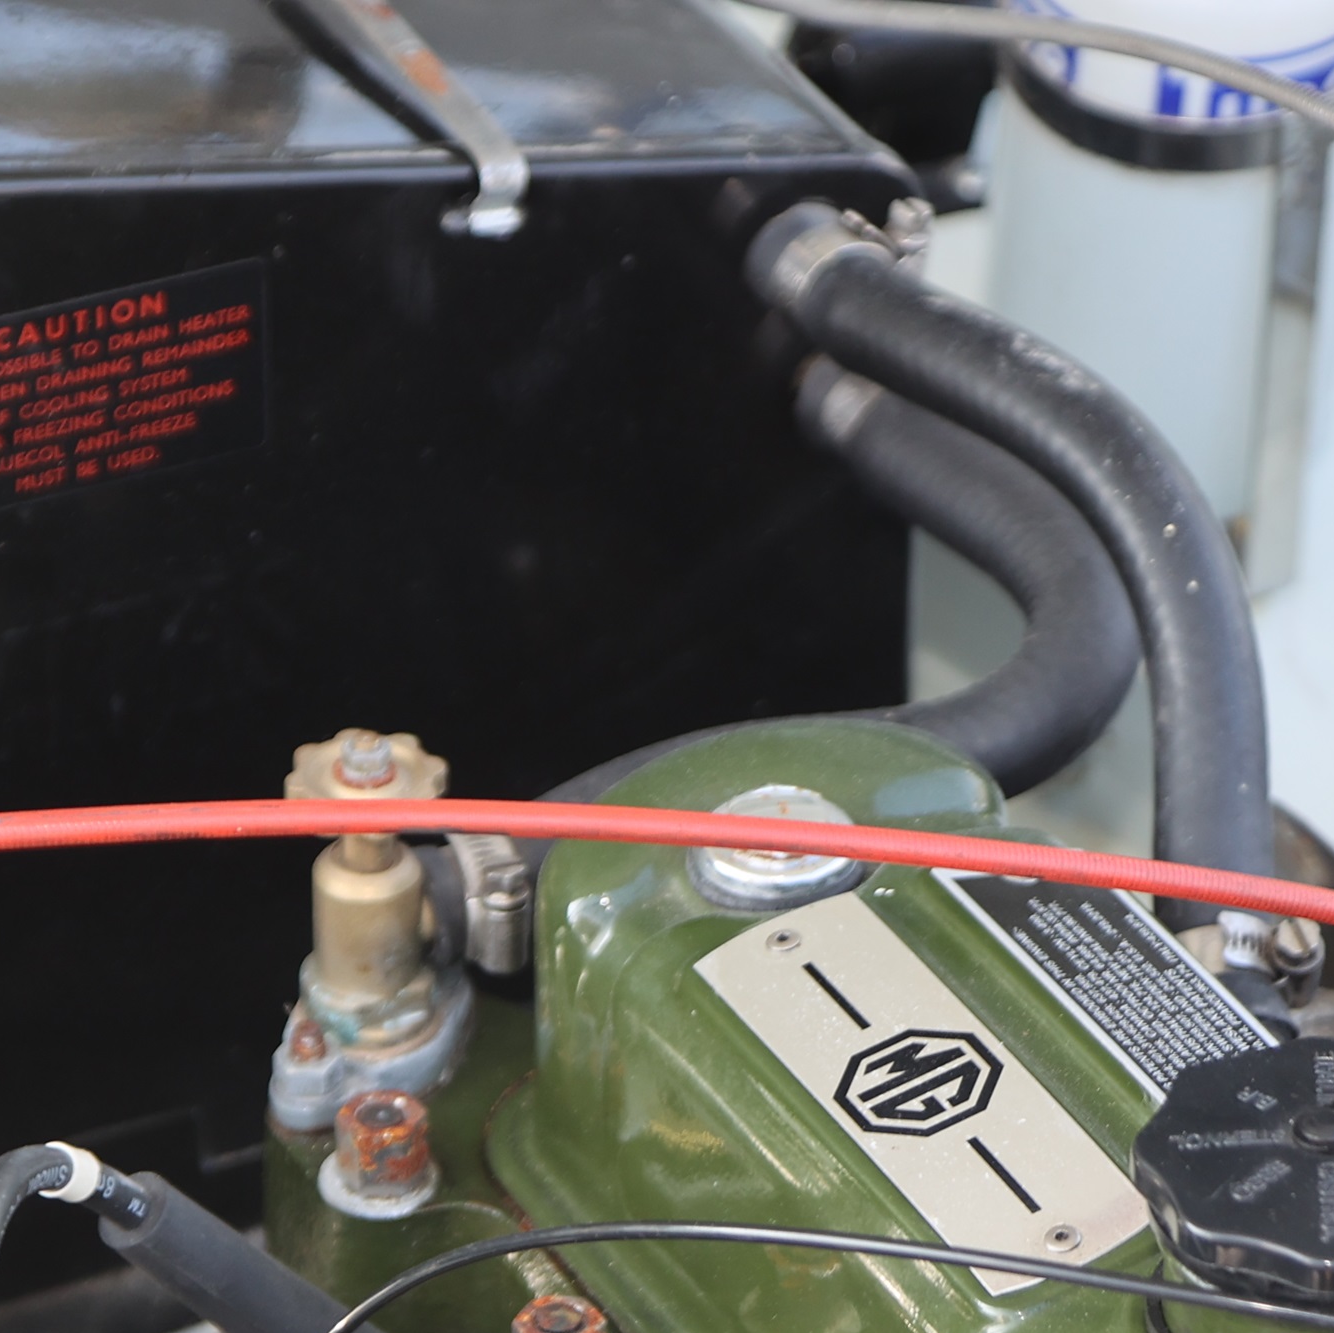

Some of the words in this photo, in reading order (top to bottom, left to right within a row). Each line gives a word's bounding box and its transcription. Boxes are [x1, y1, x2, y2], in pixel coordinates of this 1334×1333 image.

[71, 340, 99, 359] TO
[108, 326, 168, 351] DRAIN
[178, 304, 252, 334] HEATER
[36, 357, 132, 391] DRAINING
[142, 328, 250, 368] REMAINDER
[13, 409, 105, 446] FREEZING
[114, 380, 234, 421] CONDITIONS
[19, 385, 110, 420] COOLING
[119, 368, 188, 397] SYSTEM
[74, 412, 196, 453] ANTI-FREEZE
[15, 467, 66, 492] MUST
[76, 460, 98, 479] BE
[107, 445, 161, 470] USED.
[857, 1041, 982, 1122] MG
